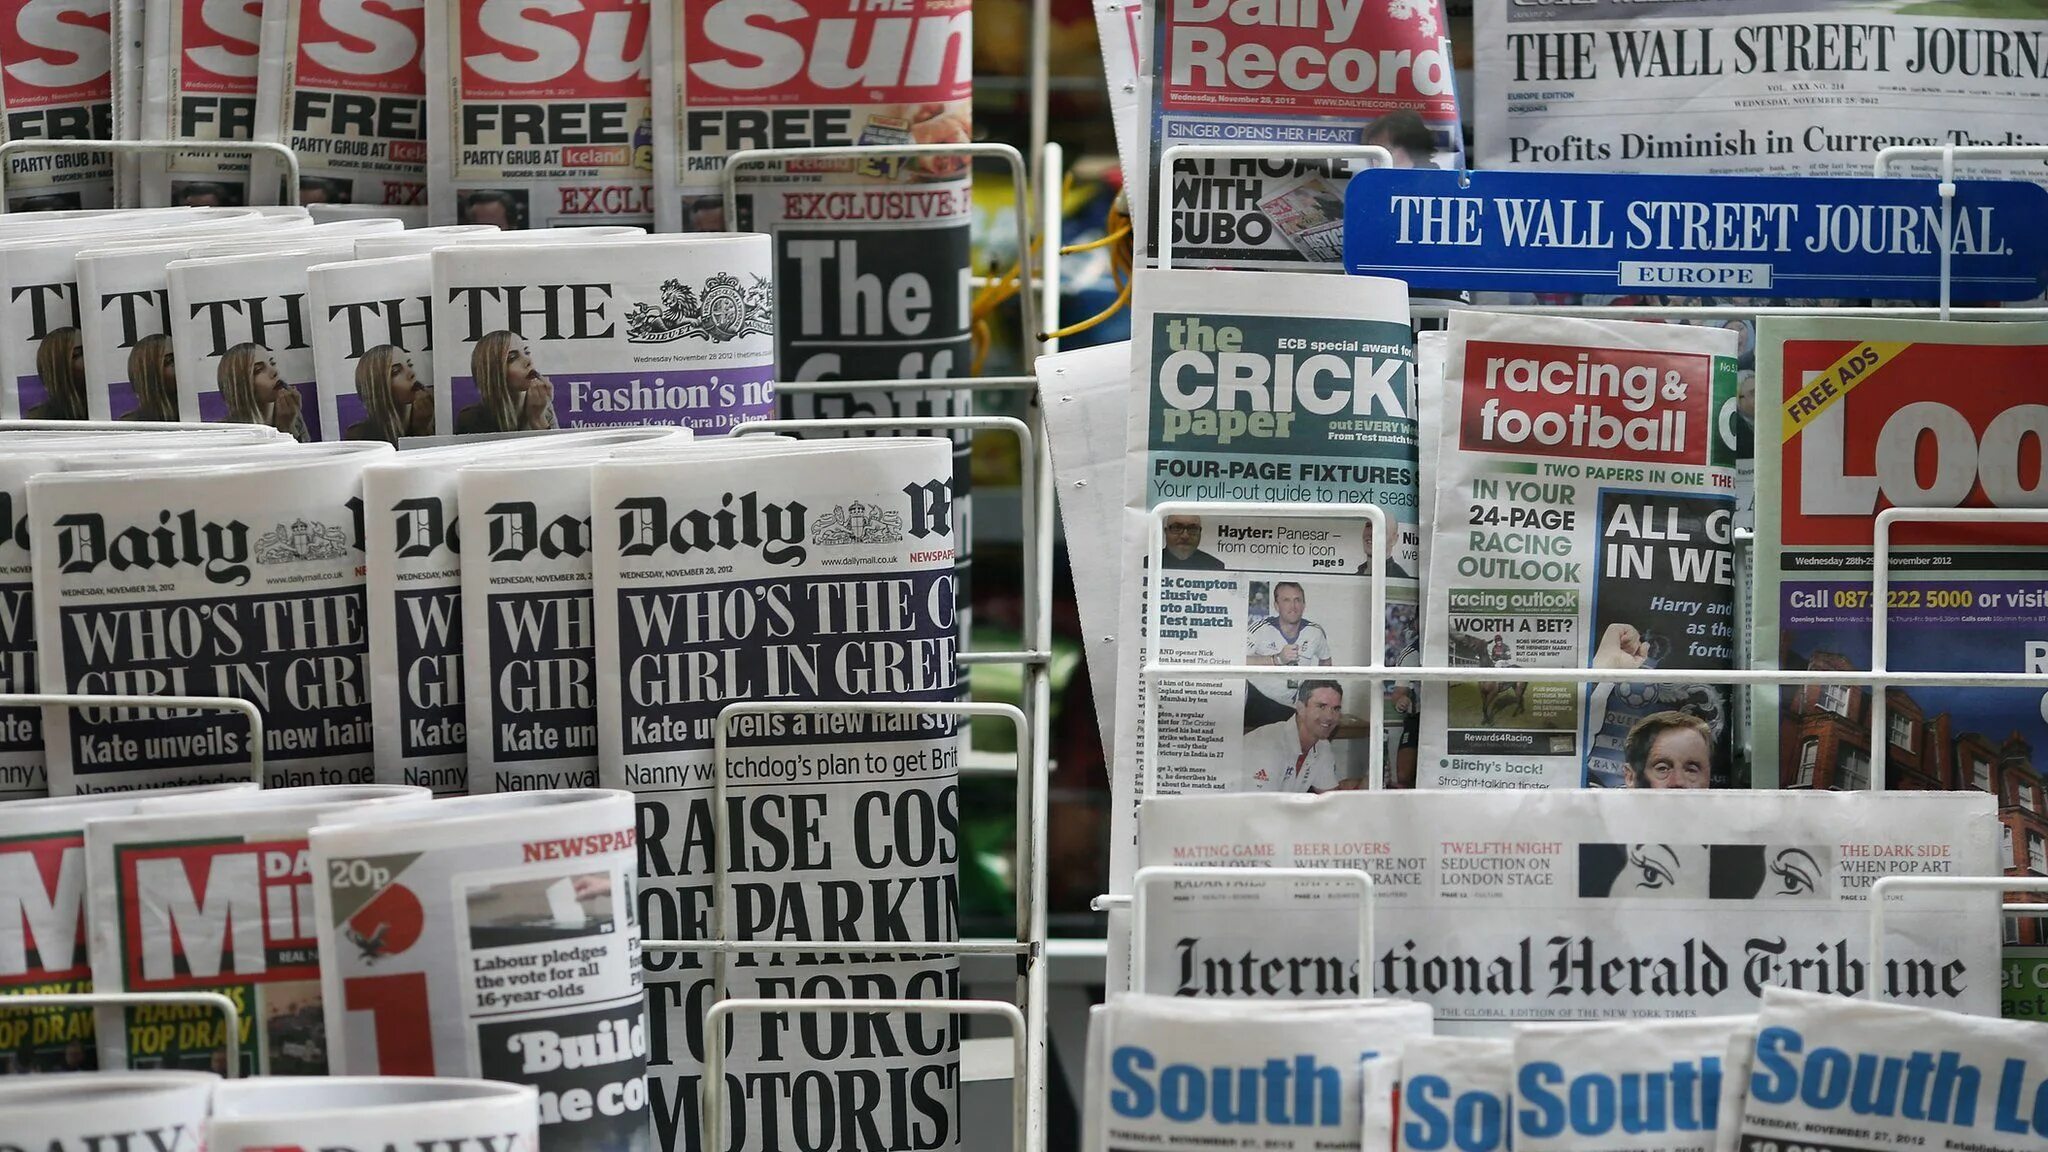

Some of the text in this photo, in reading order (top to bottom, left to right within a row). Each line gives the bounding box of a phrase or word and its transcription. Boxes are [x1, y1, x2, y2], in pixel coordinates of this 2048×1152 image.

[1173, 0, 1366, 43] Daily
[688, 0, 972, 89] Sun
[1507, 31, 1597, 81] THE
[1606, 28, 1724, 78] WALL
[1733, 23, 1896, 74] STREET
[1170, 26, 1454, 96] Record
[1542, 91, 1575, 99] EDITION
[463, 103, 629, 145] FREE
[687, 109, 853, 151] FREE
[1171, 123, 1355, 142] SINGER OPENS HER HEART
[463, 149, 626, 166] PARTY GRUB AT Iceland
[1509, 125, 1939, 163] Profits Diminish in Currency
[782, 191, 957, 221] EXCLUSIVE:
[1173, 178, 1263, 210] WITH
[1171, 212, 1273, 246] SUBO
[1391, 196, 2014, 257] THE WALL STREET JOURNAL.
[786, 239, 933, 337] The
[1638, 266, 1754, 285] EUROPE
[448, 283, 615, 343] THE
[1166, 318, 1243, 352] the
[1278, 338, 1399, 355] ECB special award
[634, 355, 672, 363] Wednesday
[673, 353, 707, 362] November
[567, 376, 737, 413] Fashion's
[1158, 349, 1418, 420] CRICK
[1485, 353, 1687, 412] racing &
[1787, 346, 1881, 424] FREE ADS
[1162, 408, 1296, 444] paper
[1328, 420, 1399, 434] out EVERY
[1328, 432, 1407, 444] From Test match
[1480, 398, 1687, 453] football
[1154, 458, 1411, 486] FOUR-PAGE FIXTURES
[1544, 463, 1704, 486] TWO PAPERS IN ONE
[1153, 479, 1374, 504] Your pull-out guide to next
[1473, 479, 1576, 505] IN YOUR
[614, 491, 808, 567] Daily
[1469, 504, 1576, 532] 24-PAGE
[1605, 503, 1690, 542] ALL
[1217, 525, 1329, 541] Hayter: Panesar
[1469, 530, 1572, 556] RACING
[53, 508, 252, 587] Daily
[821, 555, 898, 567] www.dailymail.co.uk
[1217, 539, 1336, 557] from comic to icon
[1795, 556, 1844, 567] Wednesday
[1932, 557, 1952, 566] 2012
[619, 565, 733, 580] WEDNESDAY, NOVEMBER 28, 2012
[1312, 558, 1345, 568] page 9
[1457, 557, 1581, 584] OUTLOOK
[1606, 543, 1654, 581] IN
[806, 579, 918, 636] THE
[1450, 591, 1577, 611] racing outlook
[1650, 596, 1732, 616] Harry and
[1790, 589, 1829, 608] Call
[1887, 591, 1921, 608] 222
[1926, 590, 1973, 608] 5000
[1978, 593, 2001, 608] or
[2006, 589, 2048, 608] visit
[1454, 618, 1573, 633] WORTH A BET?
[629, 645, 752, 708] GIRL
[763, 642, 822, 699] IN
[631, 711, 688, 746] Kate
[1464, 733, 1533, 744] Rewards4Racing
[625, 751, 929, 787] Nanny plan to get
[1452, 758, 1544, 775] Birchy's back!
[636, 793, 832, 878] RAISE
[1294, 842, 1391, 857] BEER LOVERS
[1441, 842, 1563, 855] TWELFTH NIGHT
[1173, 843, 1276, 859] MATING GAME
[1294, 859, 1326, 870] WHY
[1396, 857, 1427, 870] NOT
[1441, 857, 1551, 870] SEDUCTION ON
[1840, 844, 1951, 857] THE DARK SIDE
[330, 858, 390, 889] 20p
[1441, 873, 1553, 886] LONDON STAGE
[1840, 860, 1952, 873] WHEN POP ART
[473, 953, 538, 972] Labour
[542, 945, 608, 968] pledges
[1546, 936, 1729, 1000] Herald
[475, 962, 600, 990] the vote for all
[476, 985, 586, 1008] 16-year-olds
[1440, 1007, 1697, 1018] THE GLOBAL EDITION OF THE NEW YORK TIMES
[1110, 1046, 1342, 1127] South
[1750, 1025, 1983, 1128] South
[1745, 1114, 1926, 1146] TUESDAY, NOVEMBER 27, 2012
